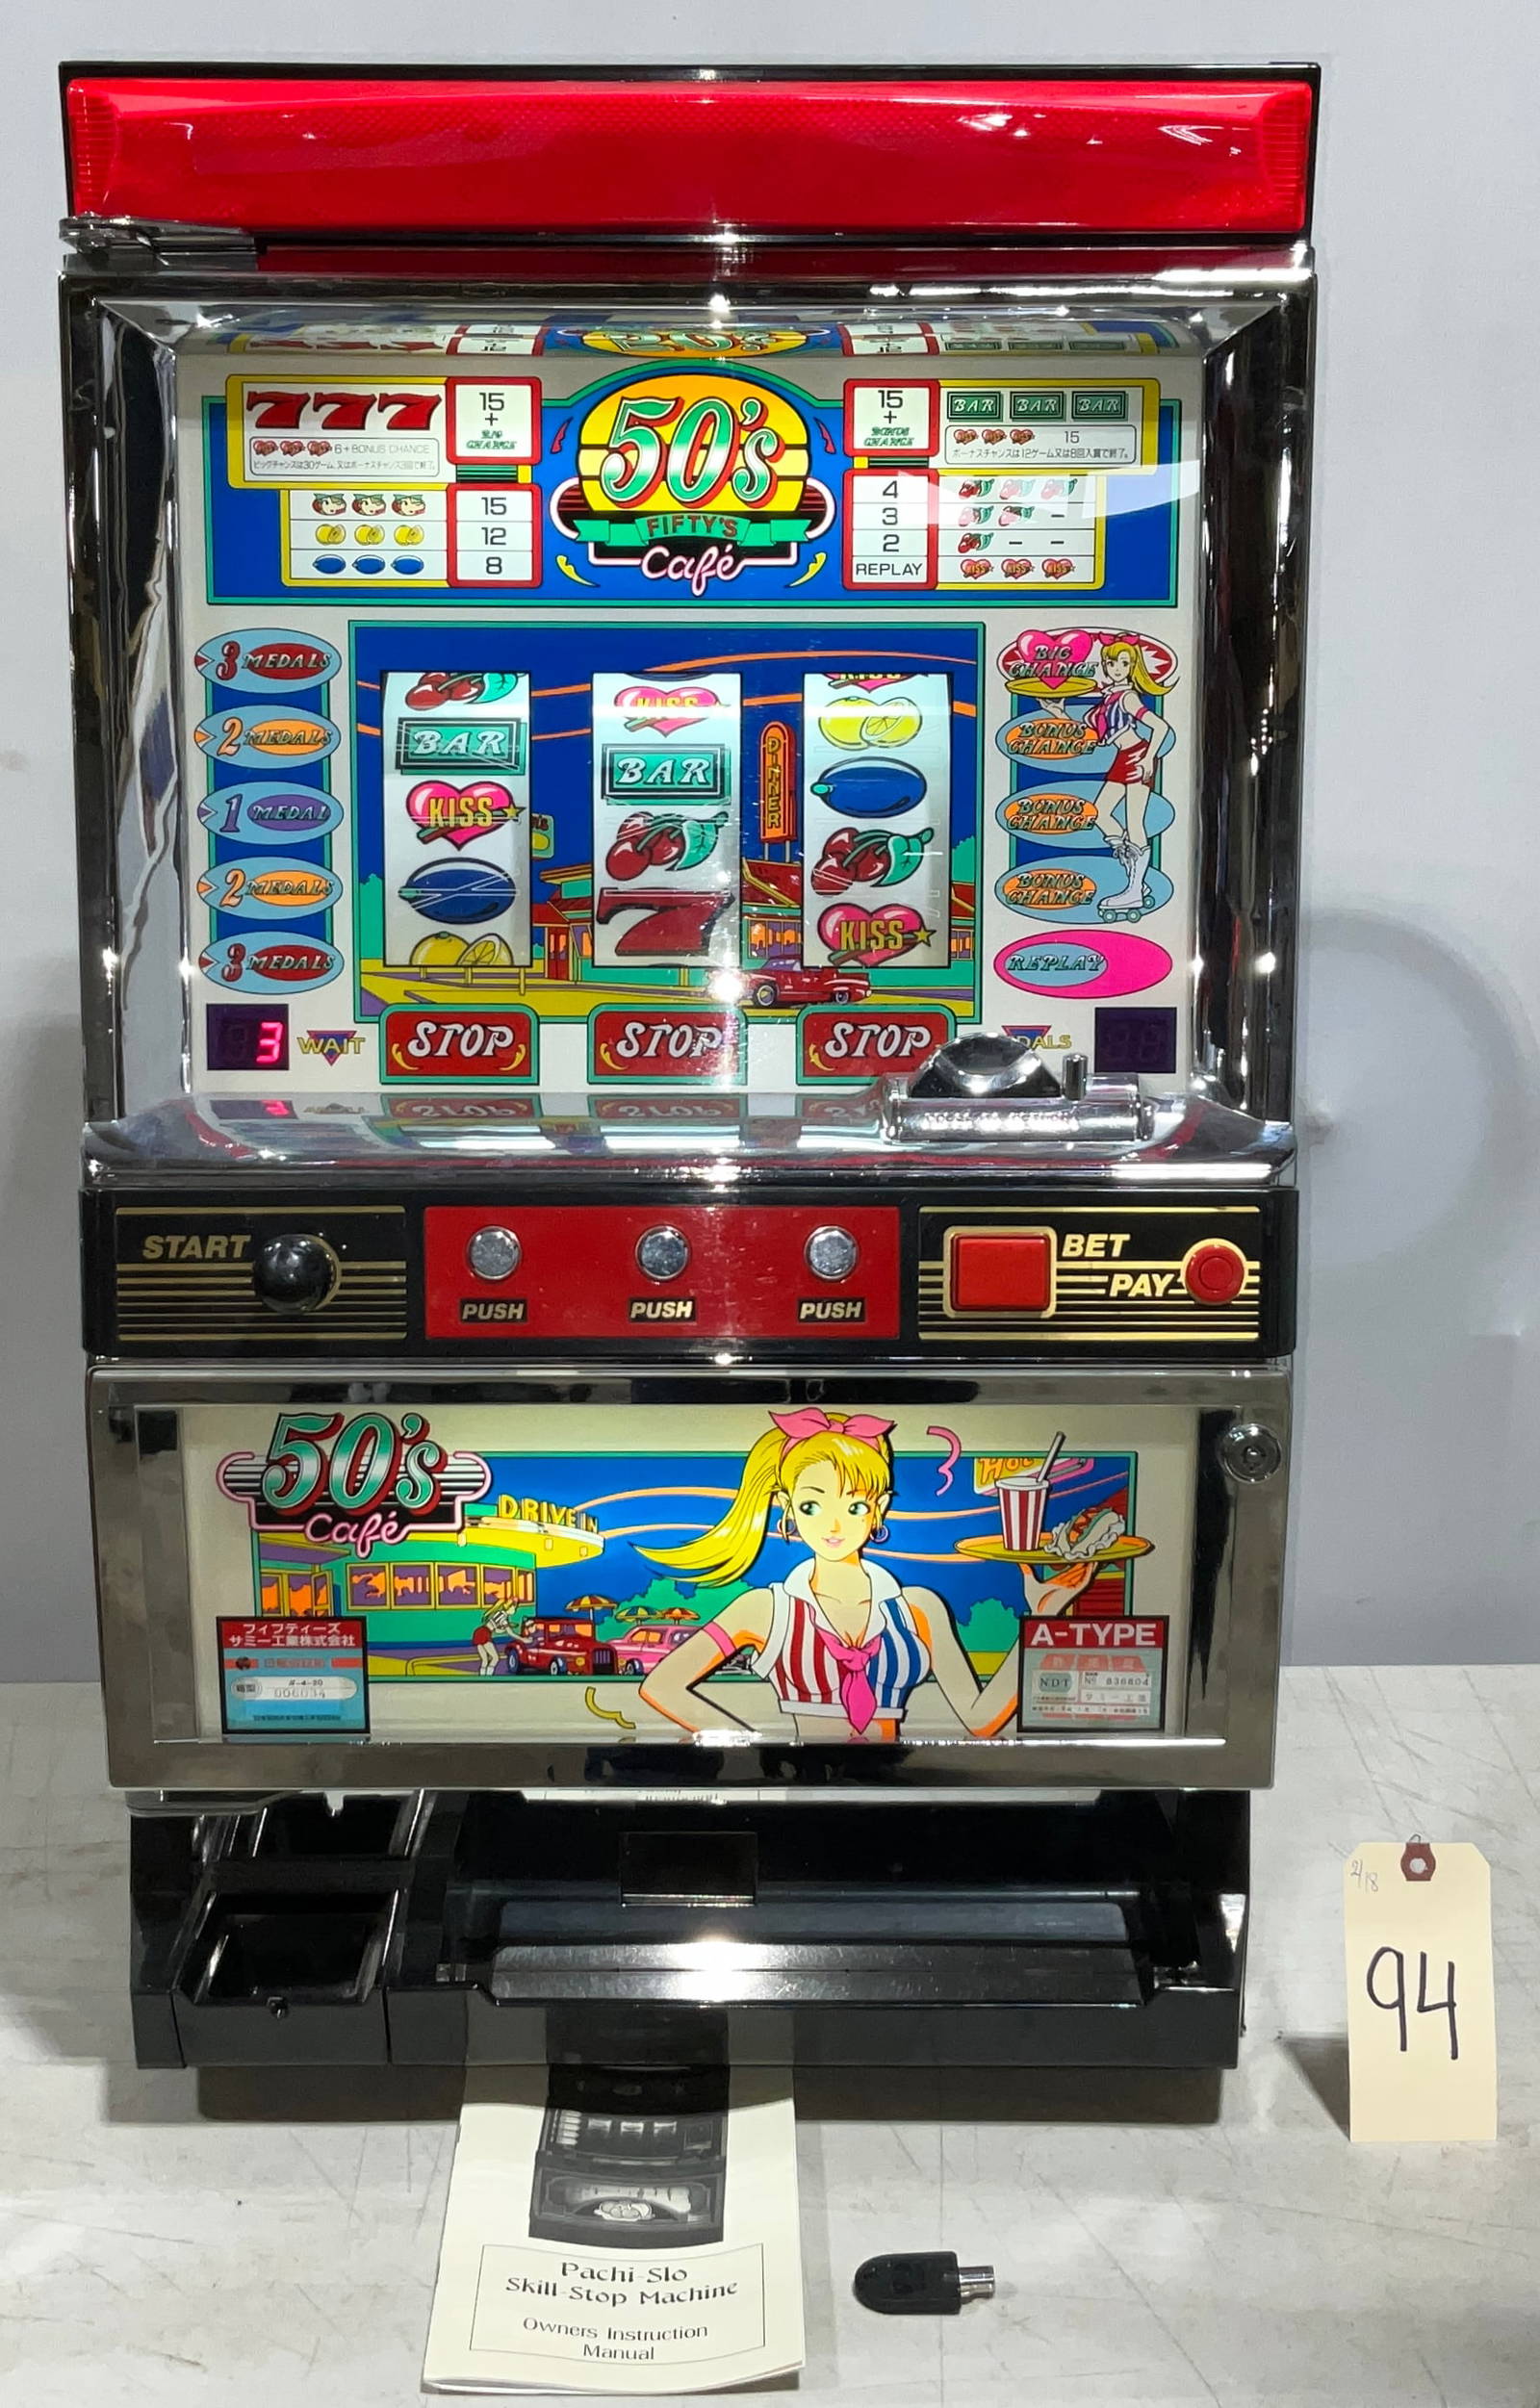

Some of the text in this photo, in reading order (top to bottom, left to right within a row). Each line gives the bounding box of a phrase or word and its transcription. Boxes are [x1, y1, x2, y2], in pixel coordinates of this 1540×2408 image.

[479, 392, 504, 411] 15
[878, 390, 903, 408] 15
[953, 398, 994, 412] BAR
[1016, 398, 1057, 412] BAR
[1078, 398, 1122, 412] BAR
[1065, 430, 1080, 443] 15
[601, 397, 785, 508] 50's
[883, 481, 898, 499] 4
[481, 498, 506, 515] 15
[882, 508, 898, 525] 3
[481, 527, 506, 546] 12
[646, 515, 739, 537] FIFTY'S
[883, 534, 900, 552] 2
[486, 557, 501, 575] 8
[641, 543, 744, 596] Café
[856, 562, 922, 576] REPLAY
[216, 641, 331, 679] 3 MEDALS
[1036, 646, 1071, 660] BIG
[1009, 661, 1098, 678] CHANCE
[217, 717, 332, 756] 2 MEDALS
[1019, 723, 1089, 738] BONUS
[413, 730, 507, 756] BAR
[1008, 738, 1098, 755] CHANCE
[617, 756, 709, 785] BAR
[765, 736, 782, 829] DINNER
[220, 793, 330, 833] 1 MEDAL
[427, 796, 494, 828] KISS
[1018, 799, 1087, 815] BONUS
[1007, 815, 1097, 831] CHANCE
[219, 868, 333, 907] 2 MEDALS
[1017, 874, 1086, 889] BONUS
[1006, 890, 1095, 906] CHANCE
[840, 921, 904, 951] KISS
[221, 943, 334, 982] 3 MEDALS
[1007, 956, 1105, 971] REPLAY
[256, 1021, 283, 1063] 3
[297, 1037, 366, 1055] WAIT
[407, 1020, 514, 1058] STOP
[617, 1021, 723, 1059] STOP
[825, 1023, 933, 1058] STOP
[141, 1235, 252, 1260] START
[1063, 1234, 1131, 1258] BET
[1110, 1273, 1174, 1297] PAY
[462, 1303, 526, 1320] PUSH
[630, 1301, 694, 1319] PUSH
[799, 1302, 863, 1319] PUSH
[261, 1412, 449, 1516] 50's
[499, 1494, 599, 1534] DRIVE IN
[305, 1510, 410, 1558] Café
[1031, 1623, 1157, 1646] A-TYPE
[1367, 1946, 1458, 2060] 94
[561, 2262, 687, 2284] Pachi-Slo
[505, 2277, 738, 2307] Skill-Stop Machine
[523, 2317, 708, 2342] Owners Instruction
[582, 2344, 654, 2361] Manual
